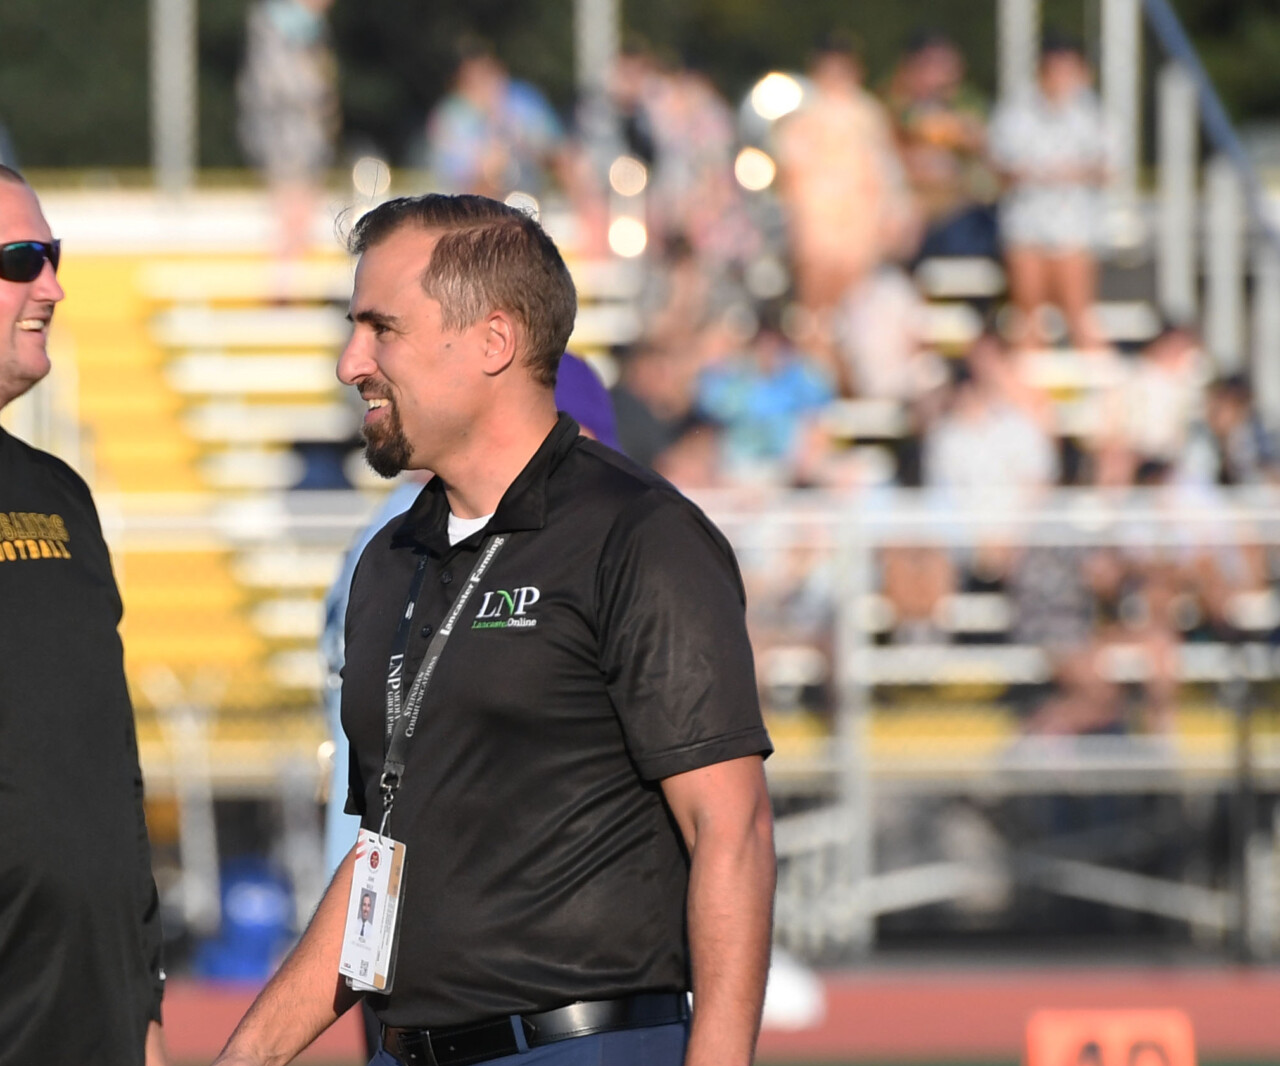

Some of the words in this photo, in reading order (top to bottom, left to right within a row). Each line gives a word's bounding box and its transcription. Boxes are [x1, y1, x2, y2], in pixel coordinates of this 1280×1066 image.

[440, 583, 475, 636] Lancaster
[470, 536, 505, 583] Farming
[475, 586, 540, 619] LNP
[387, 653, 404, 690] LNP
